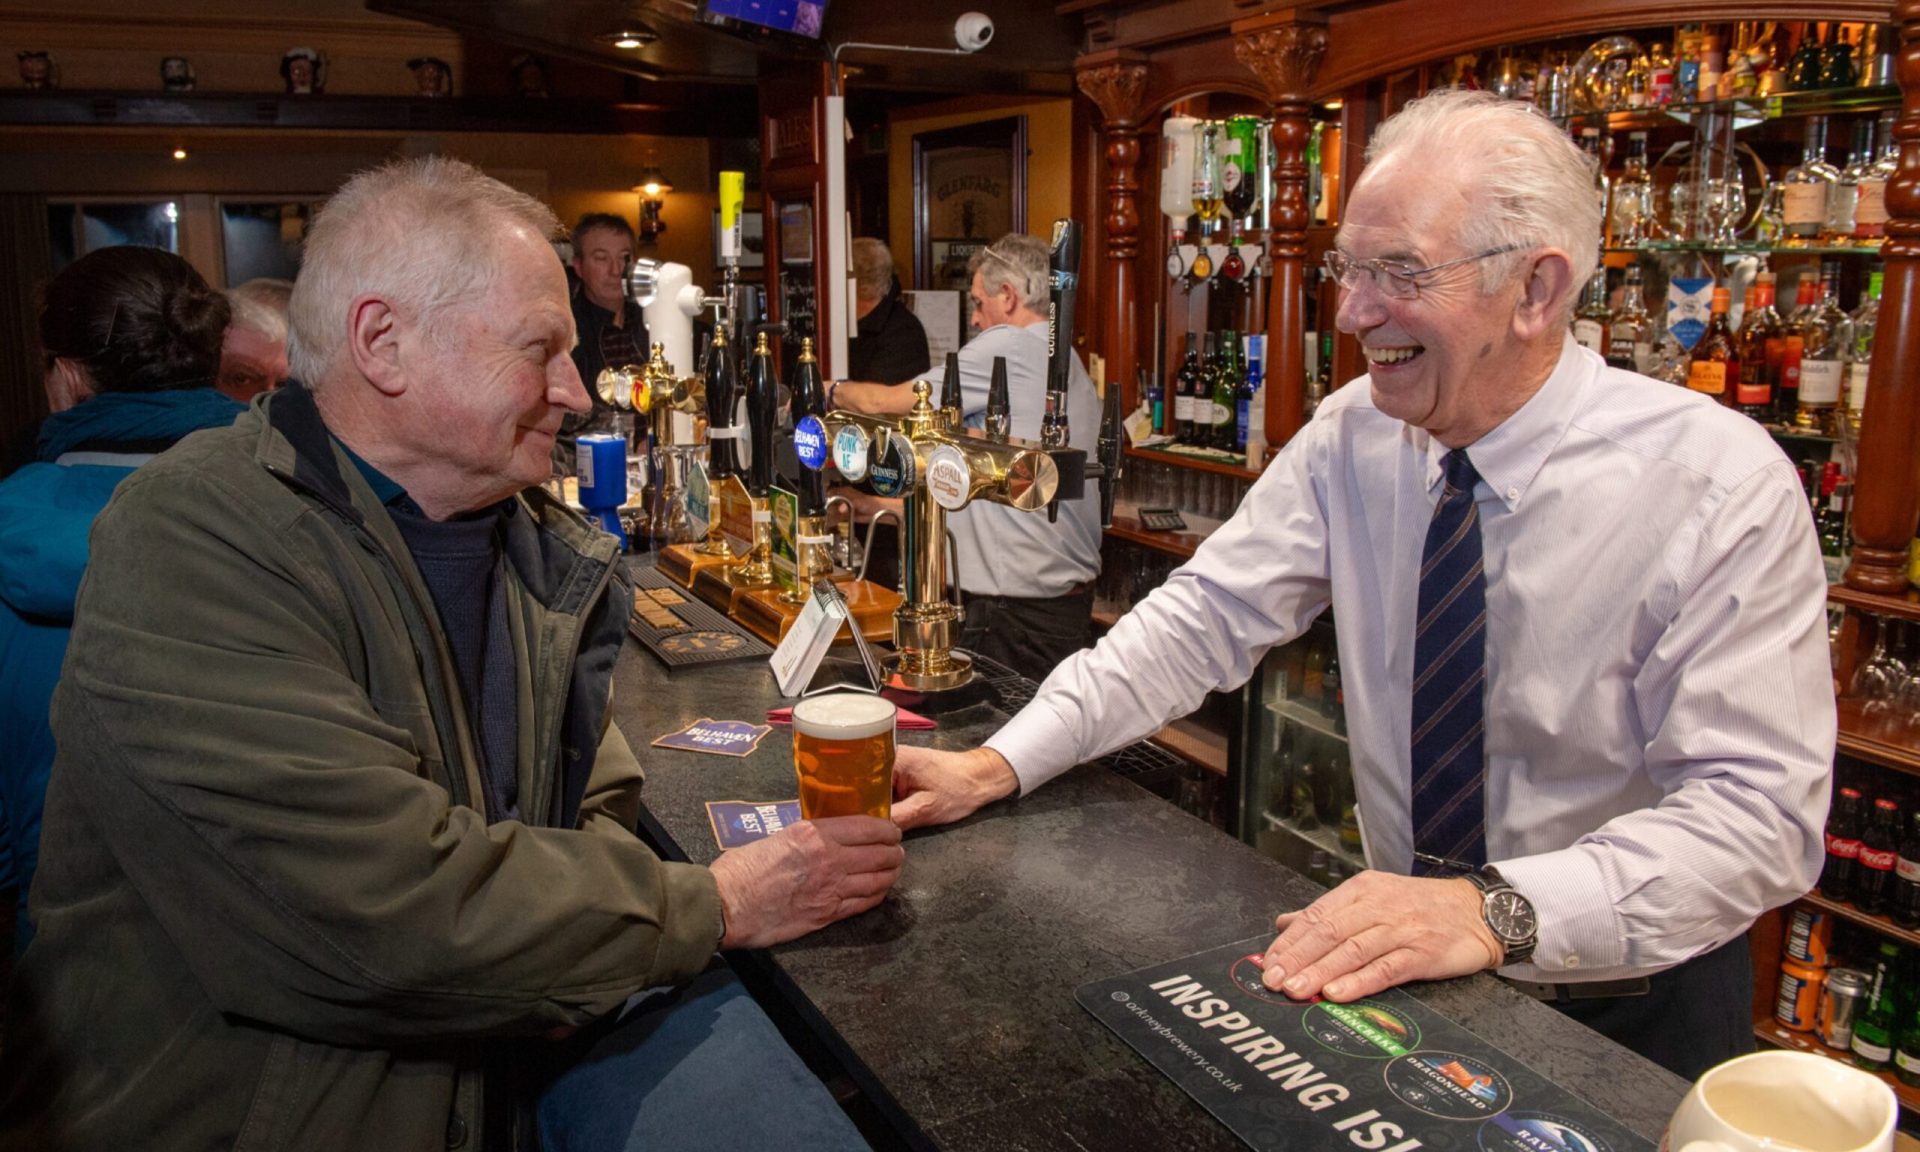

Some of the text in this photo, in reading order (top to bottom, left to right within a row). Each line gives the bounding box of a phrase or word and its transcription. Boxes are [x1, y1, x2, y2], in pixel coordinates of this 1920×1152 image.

[1048, 301, 1056, 357] GUINNESS
[795, 428, 820, 448] BELHAVEN
[838, 432, 858, 453] PUNK
[798, 445, 815, 458] BEST
[870, 463, 899, 480] GUINNESS
[934, 463, 962, 485] ASPALL
[685, 727, 758, 743] BELHAVEN
[691, 735, 735, 746] BEST
[740, 813, 762, 833] BEST
[754, 804, 785, 835] BELHAVE
[1325, 1004, 1402, 1053] CORNCRAKE
[1125, 1000, 1244, 1095] orkneybrewery.co.uk
[1150, 974, 1350, 1111] INSPIRING
[1406, 1057, 1487, 1109] DRAGONHEAD
